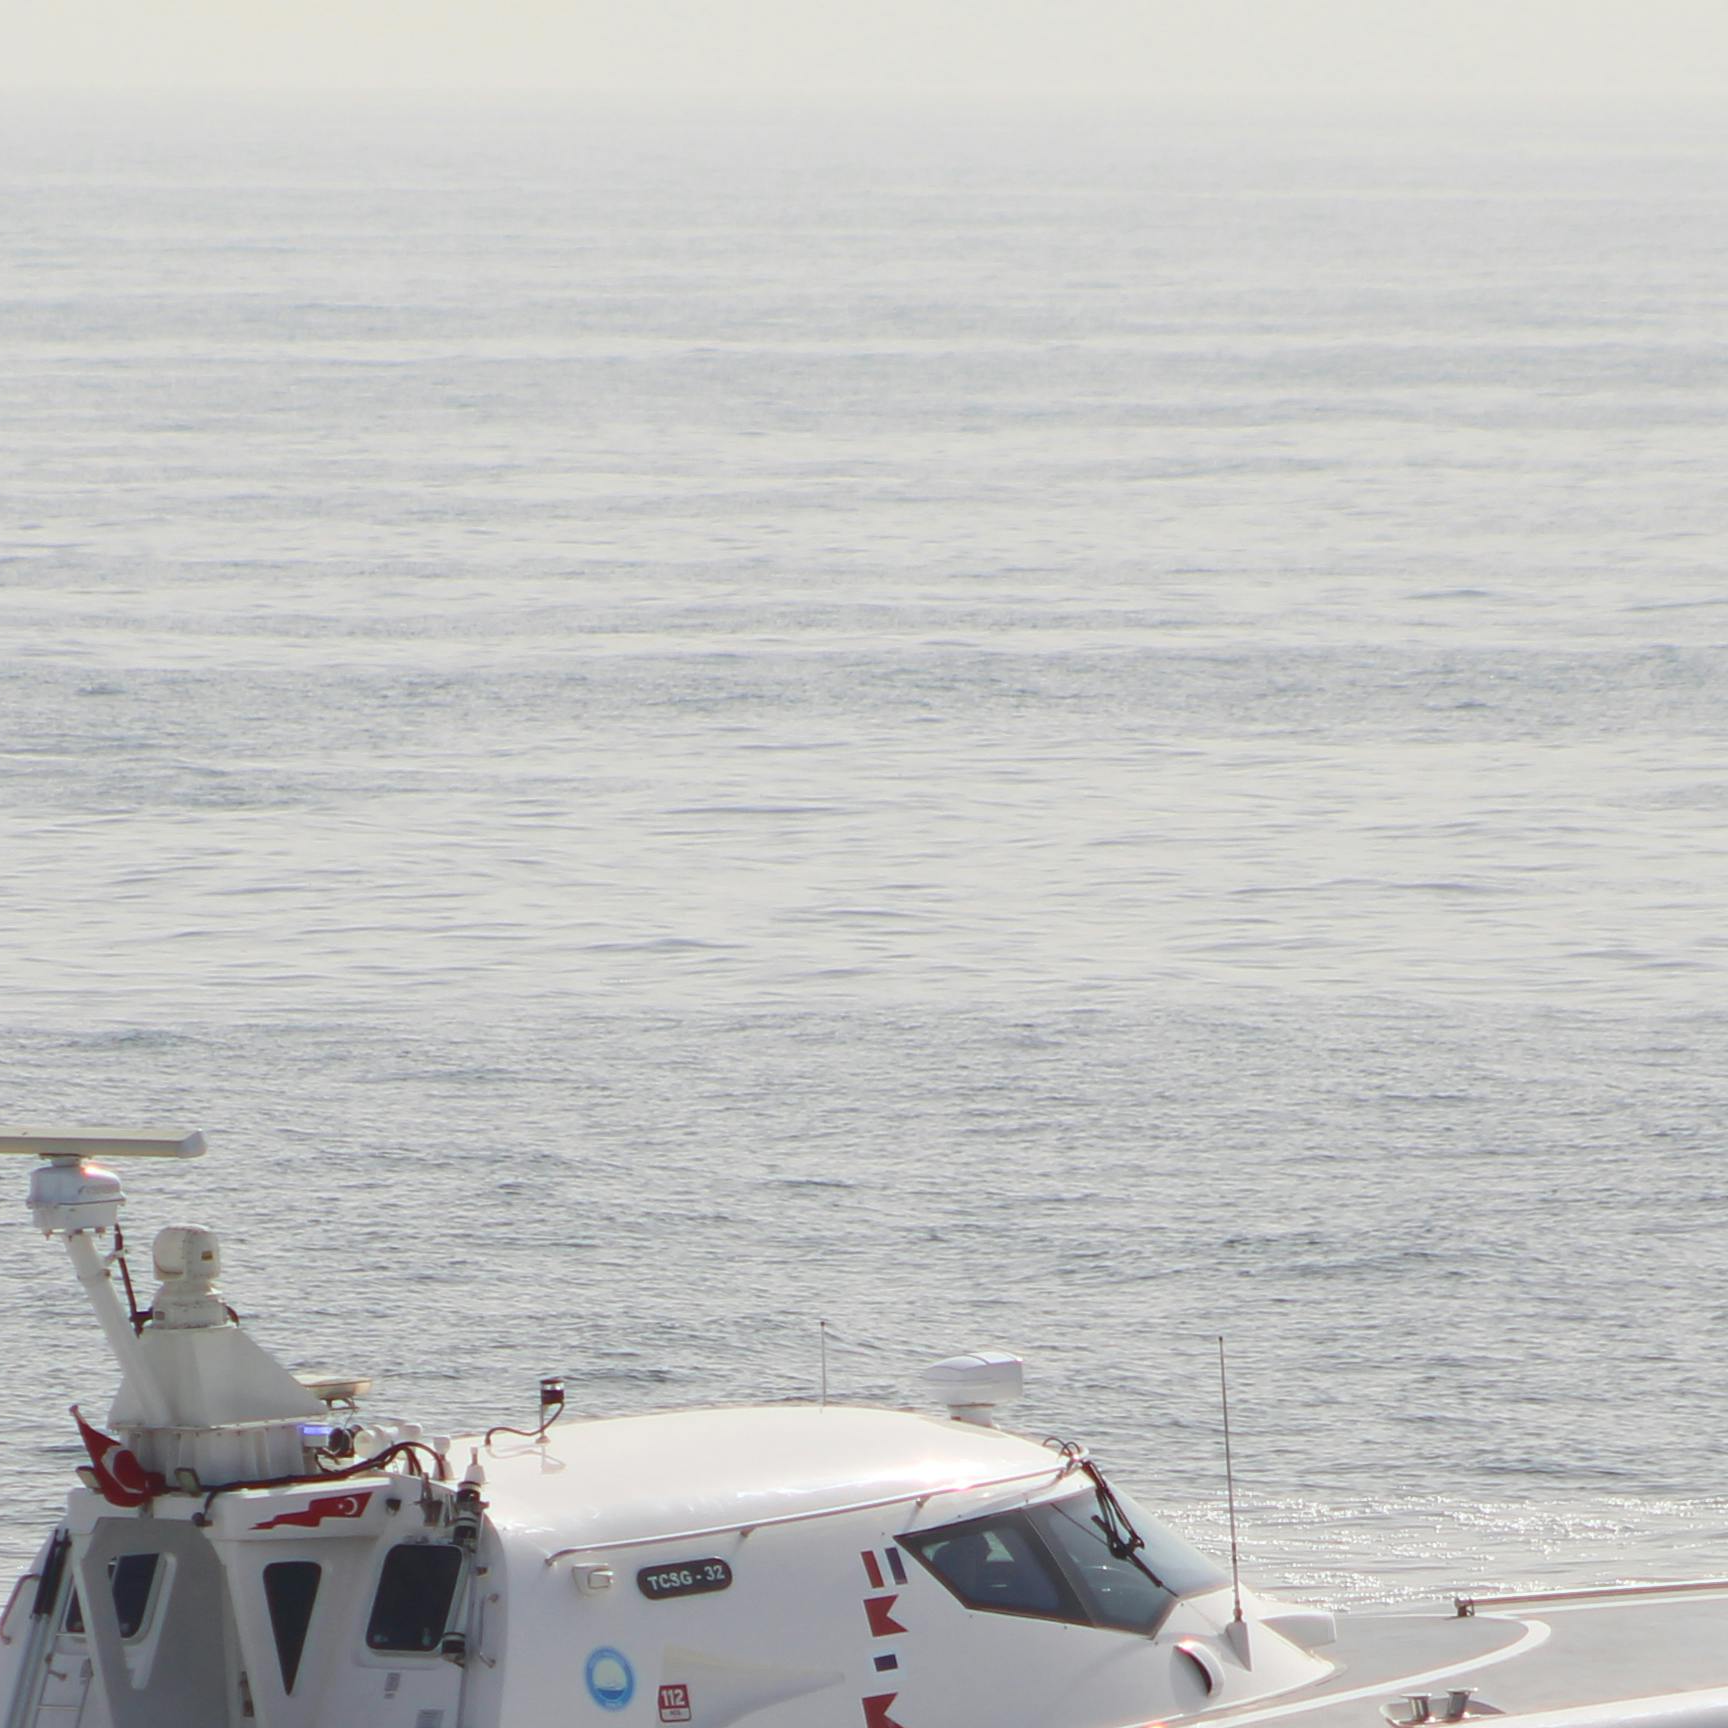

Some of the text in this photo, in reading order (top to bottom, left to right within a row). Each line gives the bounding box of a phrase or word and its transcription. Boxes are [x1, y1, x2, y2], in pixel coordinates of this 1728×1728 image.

[647, 1570, 693, 1591] TCSG
[703, 1564, 725, 1581] 32
[661, 1688, 685, 1707] 112
